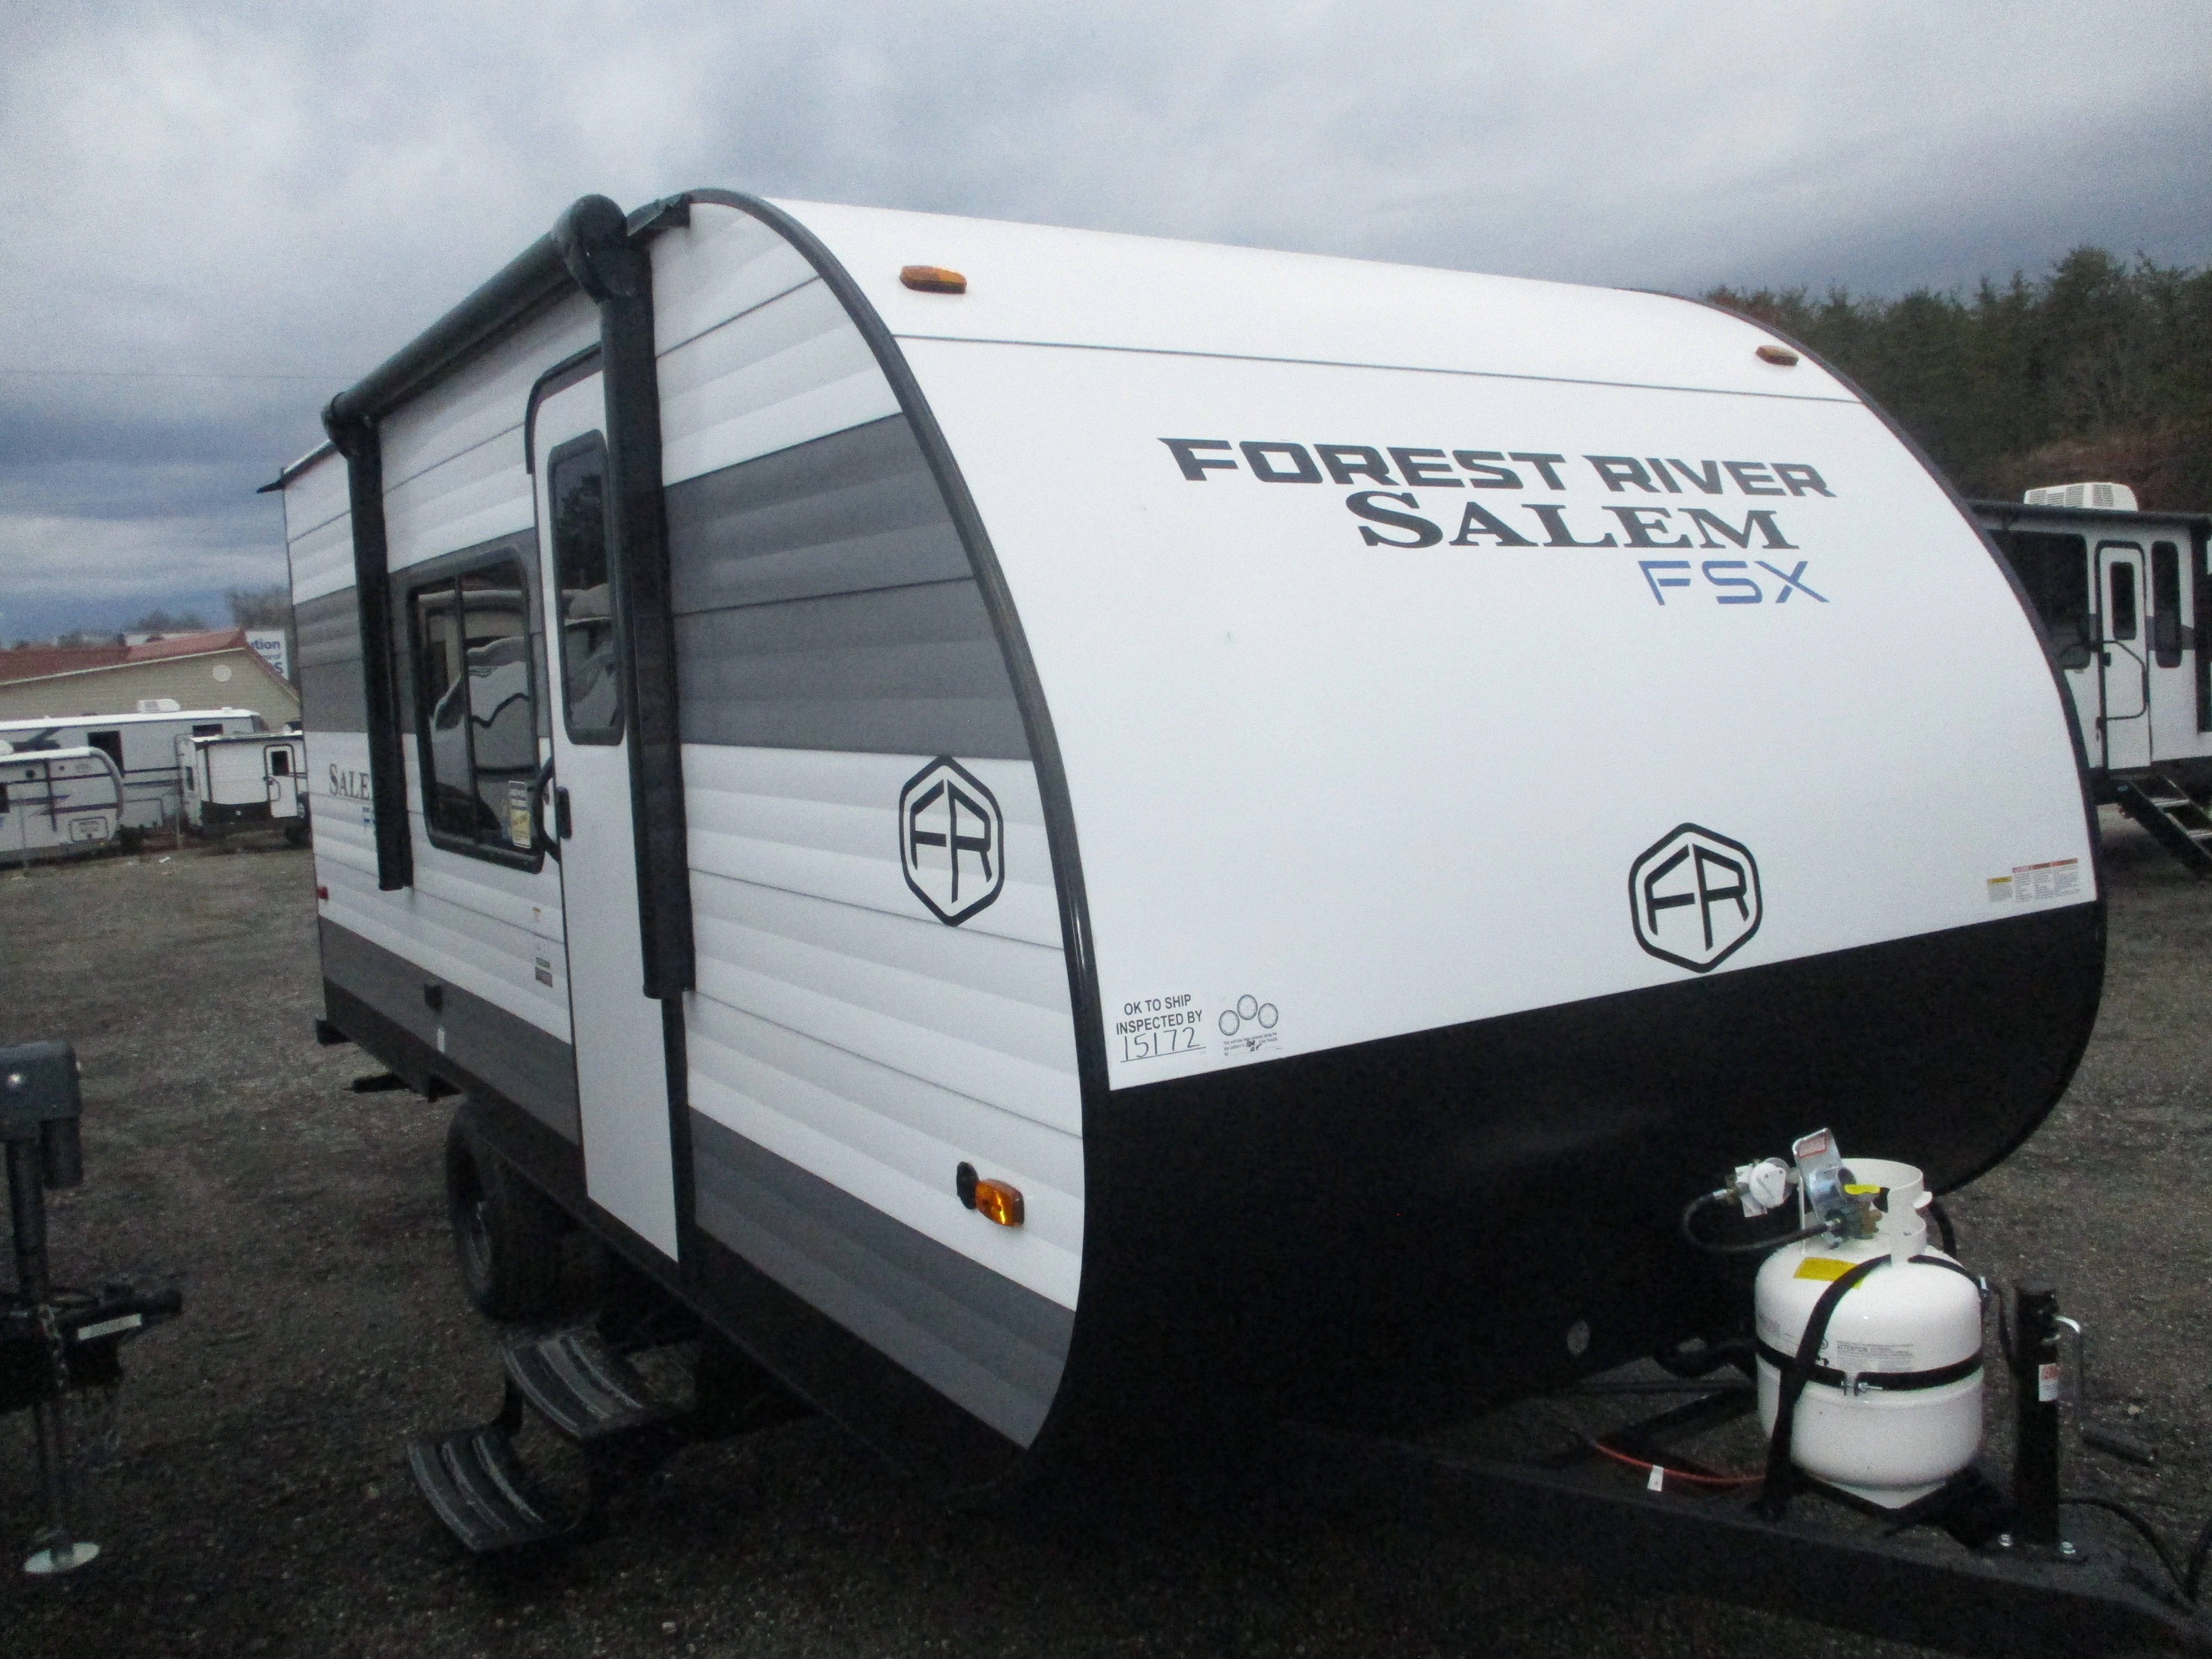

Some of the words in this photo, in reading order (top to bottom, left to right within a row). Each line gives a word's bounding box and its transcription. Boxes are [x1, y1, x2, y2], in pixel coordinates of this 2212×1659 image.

[1157, 438, 1567, 491] FOREST
[1581, 455, 1838, 498] RIVER
[1345, 491, 1799, 549] SALEM
[1637, 560, 1830, 606] FSX
[329, 763, 370, 801] SALE
[1116, 1014, 1184, 1035] INSPECTED
[1188, 1010, 1202, 1024] BY
[1124, 1002, 1142, 1015] OK
[1145, 999, 1161, 1012] TO
[1165, 994, 1191, 1009] SHIP
[1124, 1027, 1200, 1060] 15172
